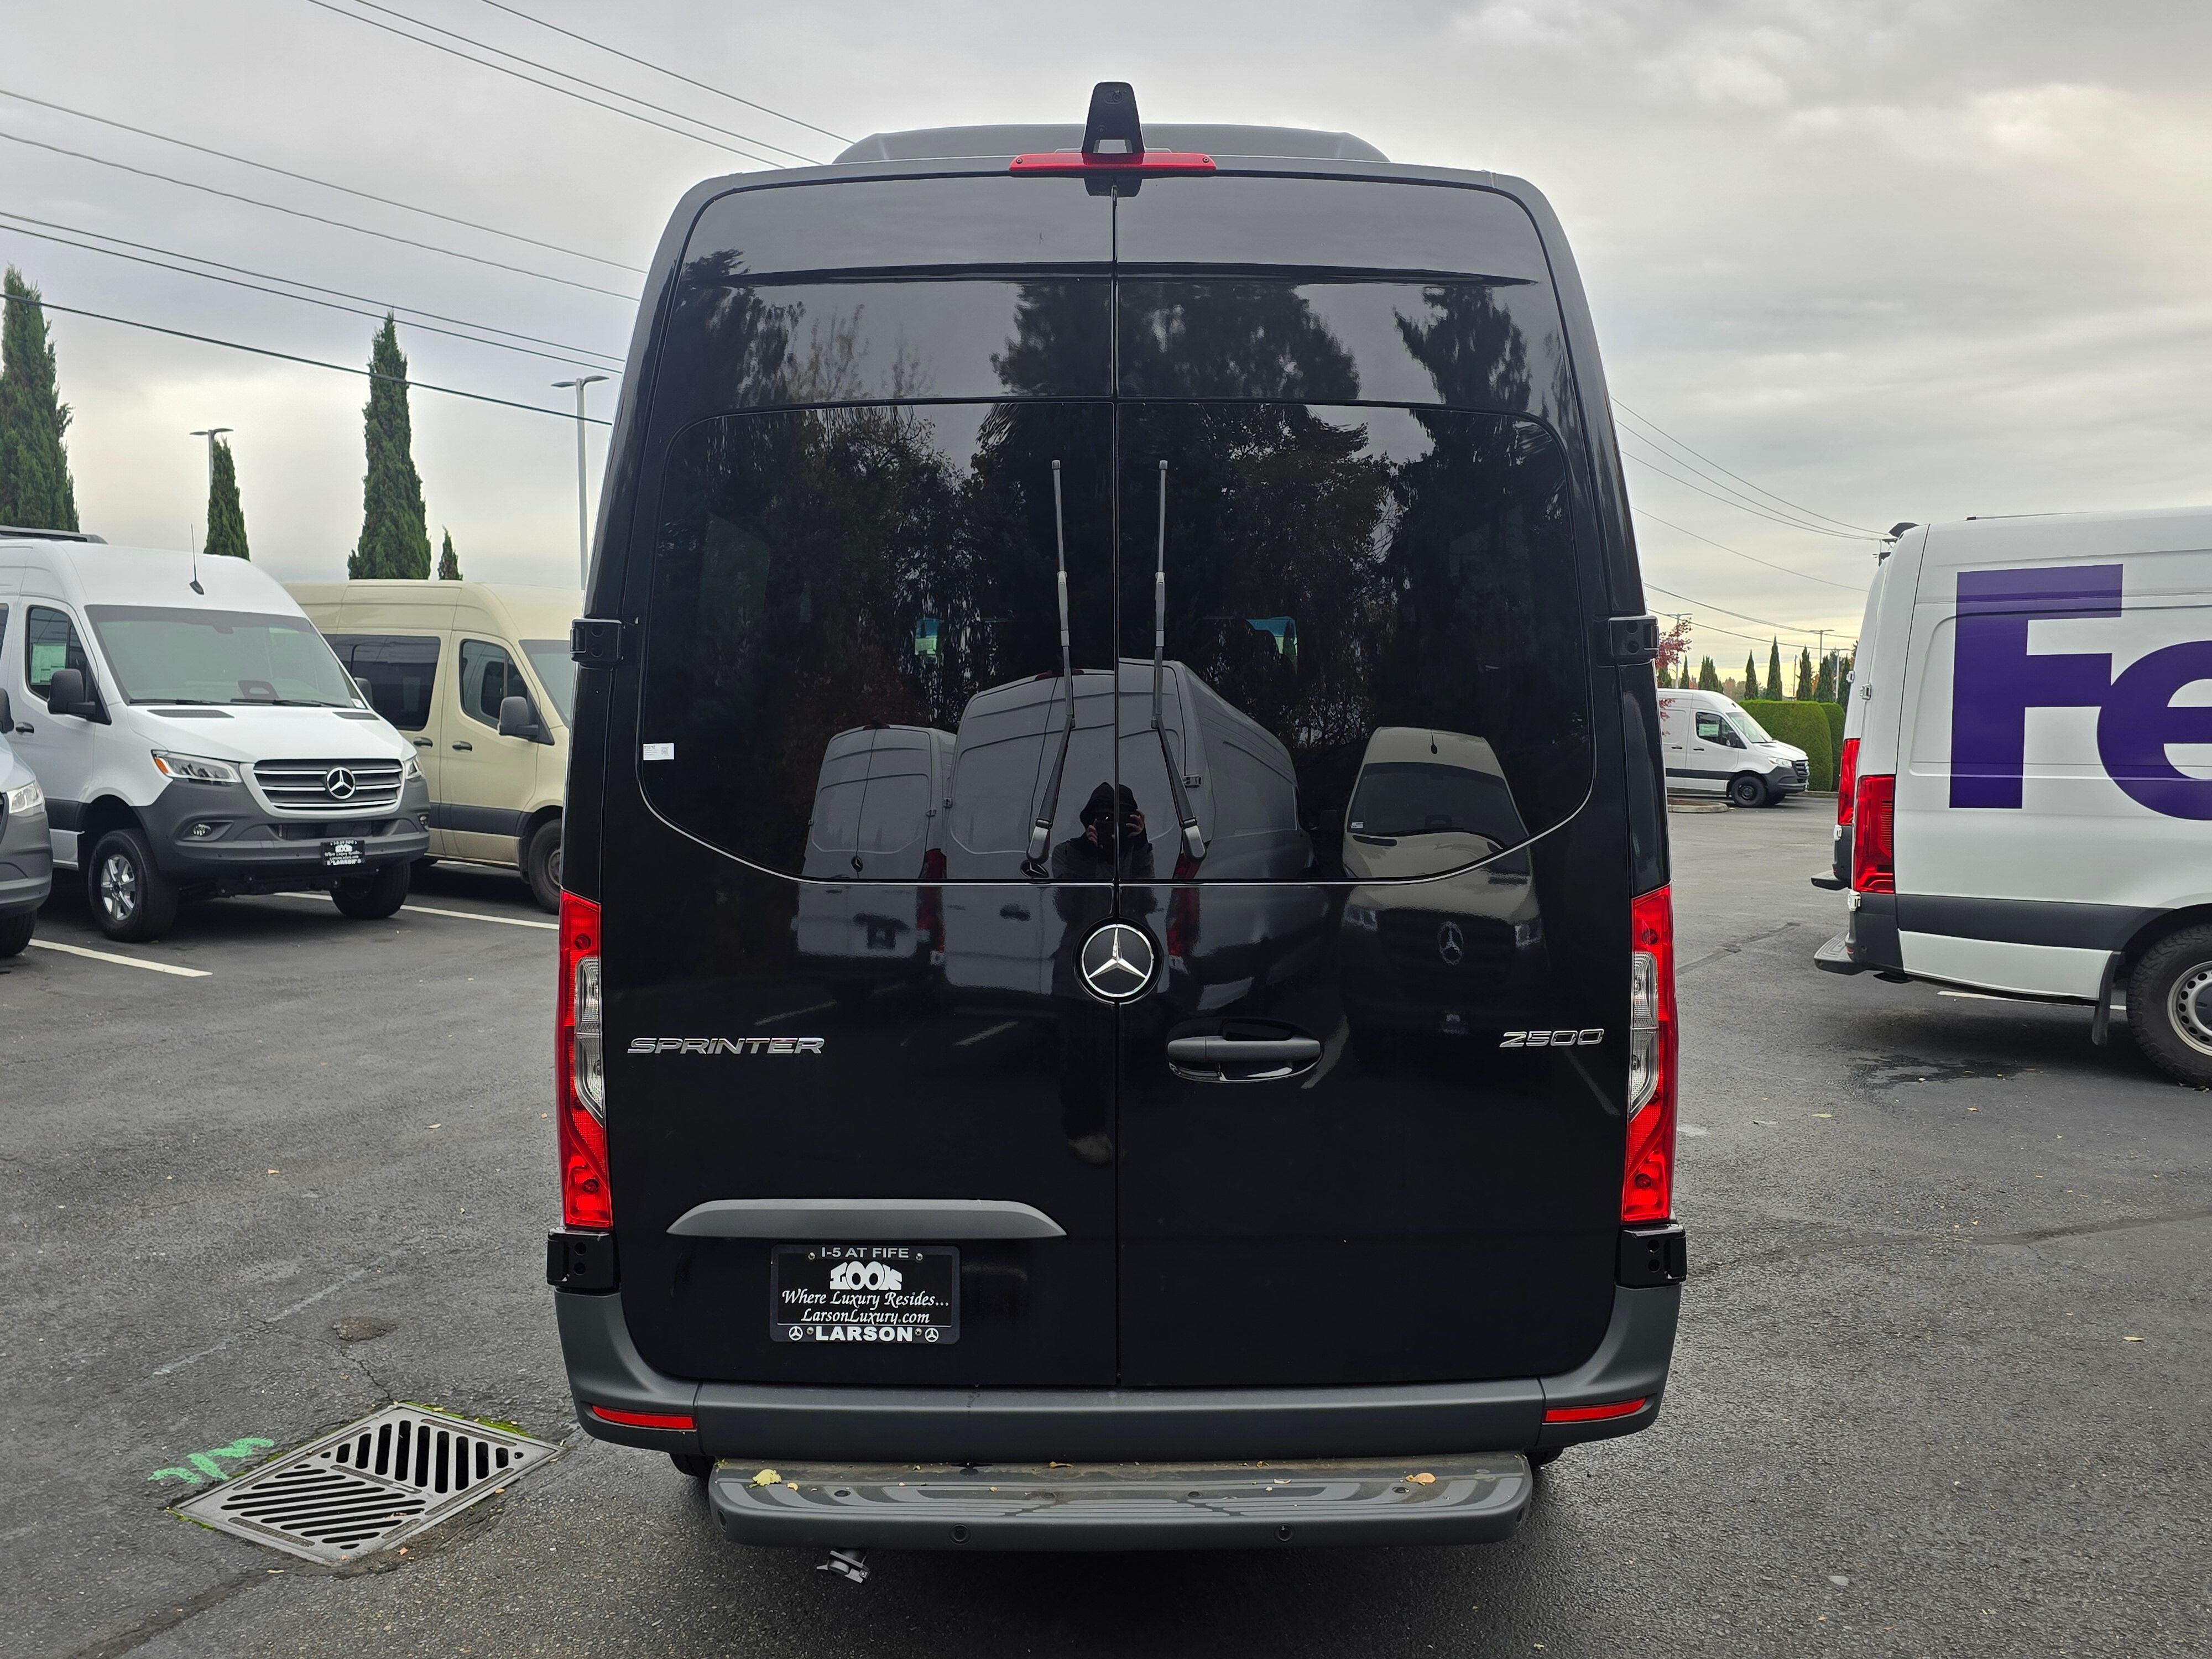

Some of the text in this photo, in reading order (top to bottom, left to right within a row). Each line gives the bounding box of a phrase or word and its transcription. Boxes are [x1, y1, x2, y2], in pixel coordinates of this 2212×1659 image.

[627, 1037, 825, 1055] SPRINTER
[1499, 1028, 1604, 1048] 2500
[821, 1247, 910, 1259] I-5 AT FIFE
[830, 1260, 902, 1291] LOOK
[781, 1288, 827, 1305] Where
[829, 1291, 880, 1310] Luxury
[801, 1308, 930, 1326] LarsonLuxury.com
[815, 1326, 912, 1342] LARSON
